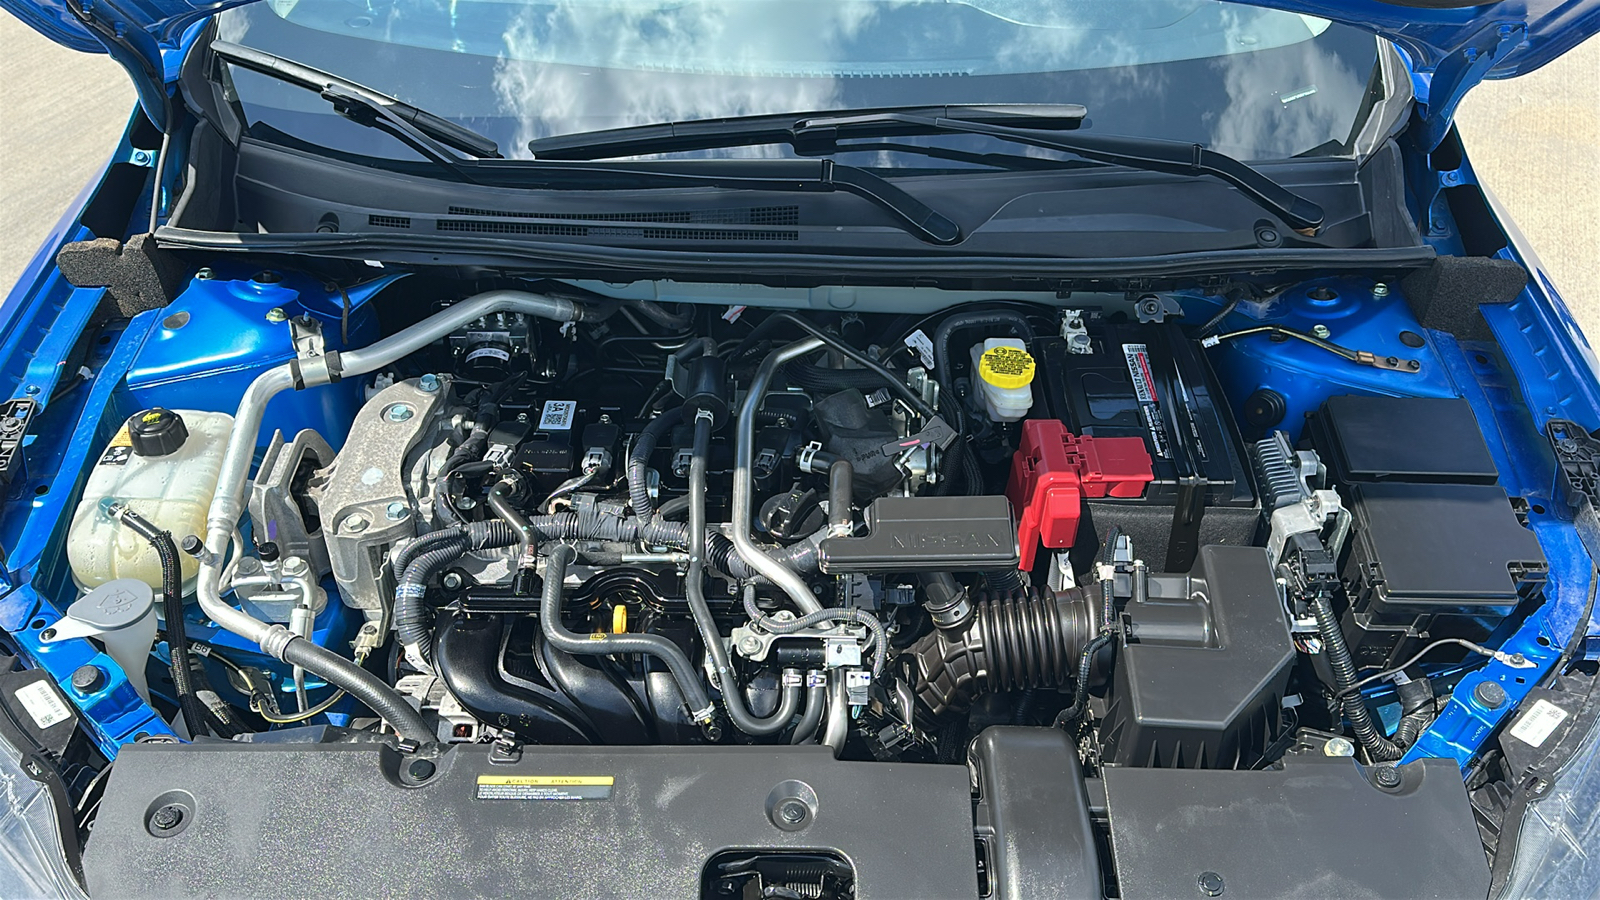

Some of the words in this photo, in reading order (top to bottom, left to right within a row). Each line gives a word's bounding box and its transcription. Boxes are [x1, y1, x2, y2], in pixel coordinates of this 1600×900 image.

[1127, 353, 1140, 379] NISSAN
[1136, 379, 1148, 400] RENAULT
[552, 403, 564, 412] 3A
[889, 532, 1007, 549] NISSAN
